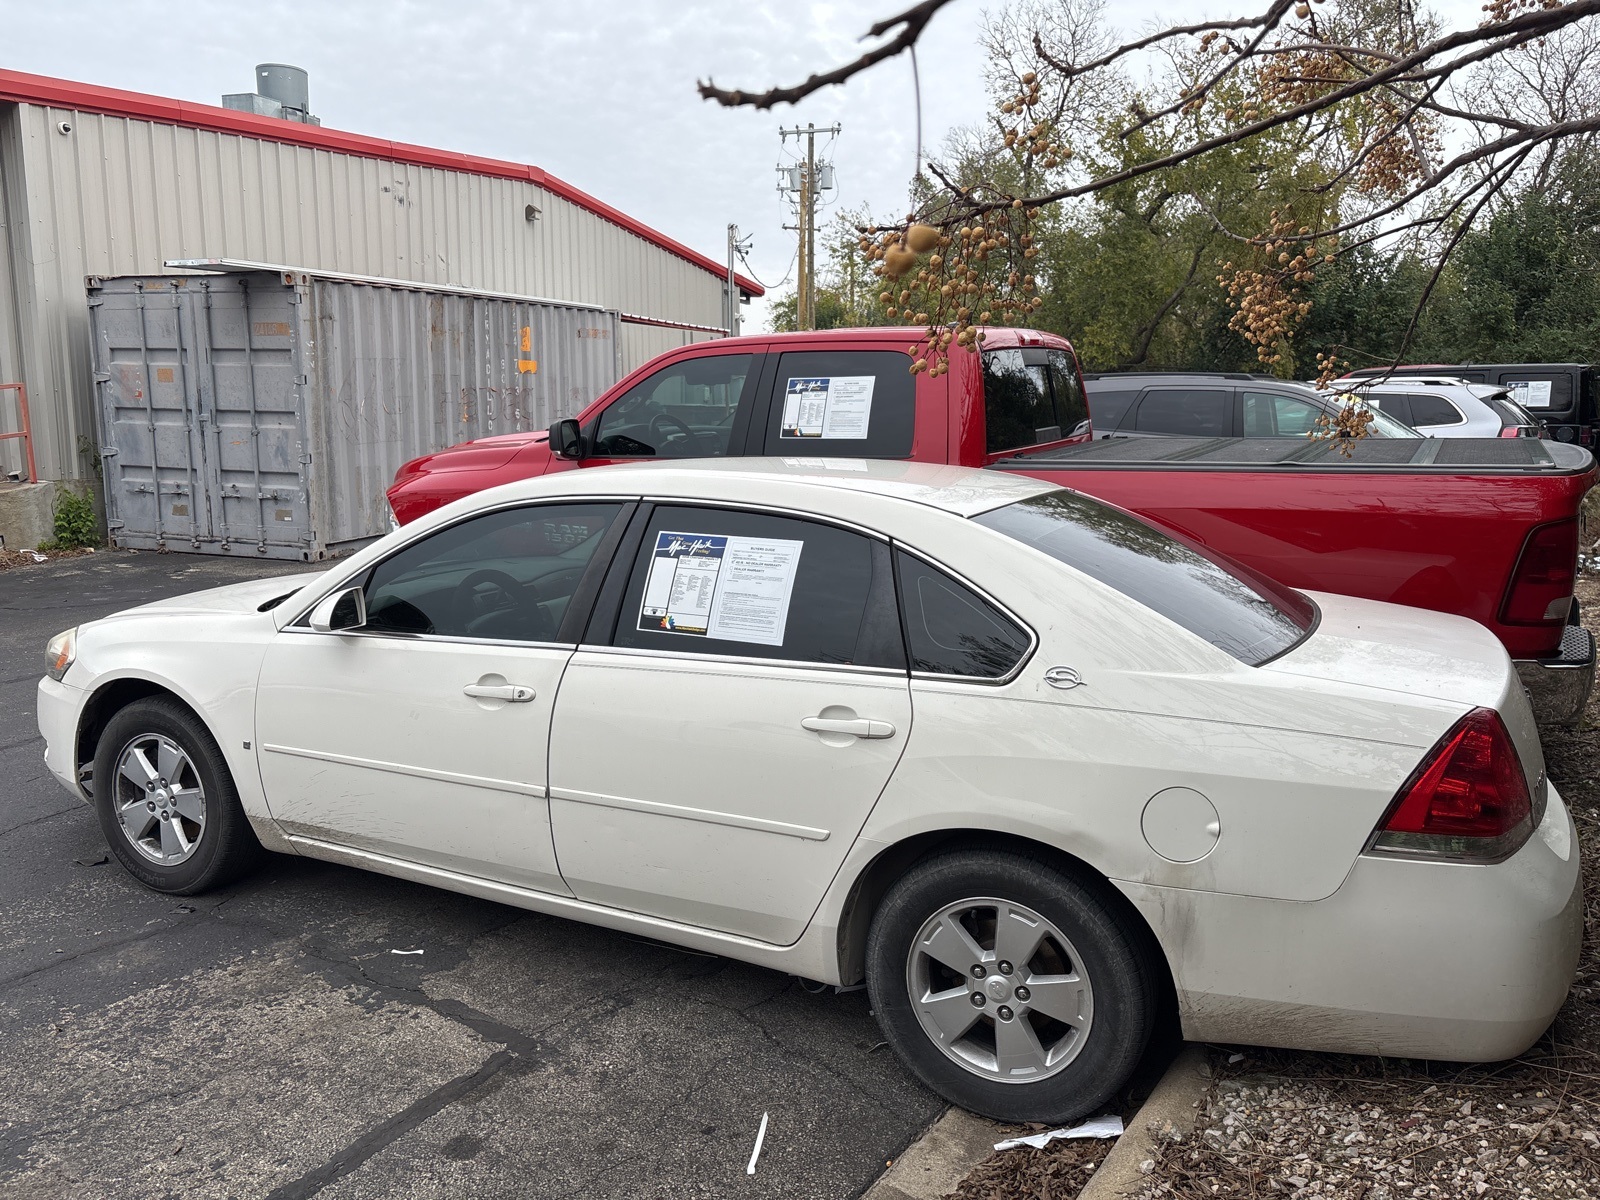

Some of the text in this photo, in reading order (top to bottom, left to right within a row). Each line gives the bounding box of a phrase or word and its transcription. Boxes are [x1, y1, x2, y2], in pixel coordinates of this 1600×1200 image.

[483, 306, 493, 431] ARMADILLO
[544, 523, 588, 534] RAM
[115, 847, 166, 887] BLACKHAWK
